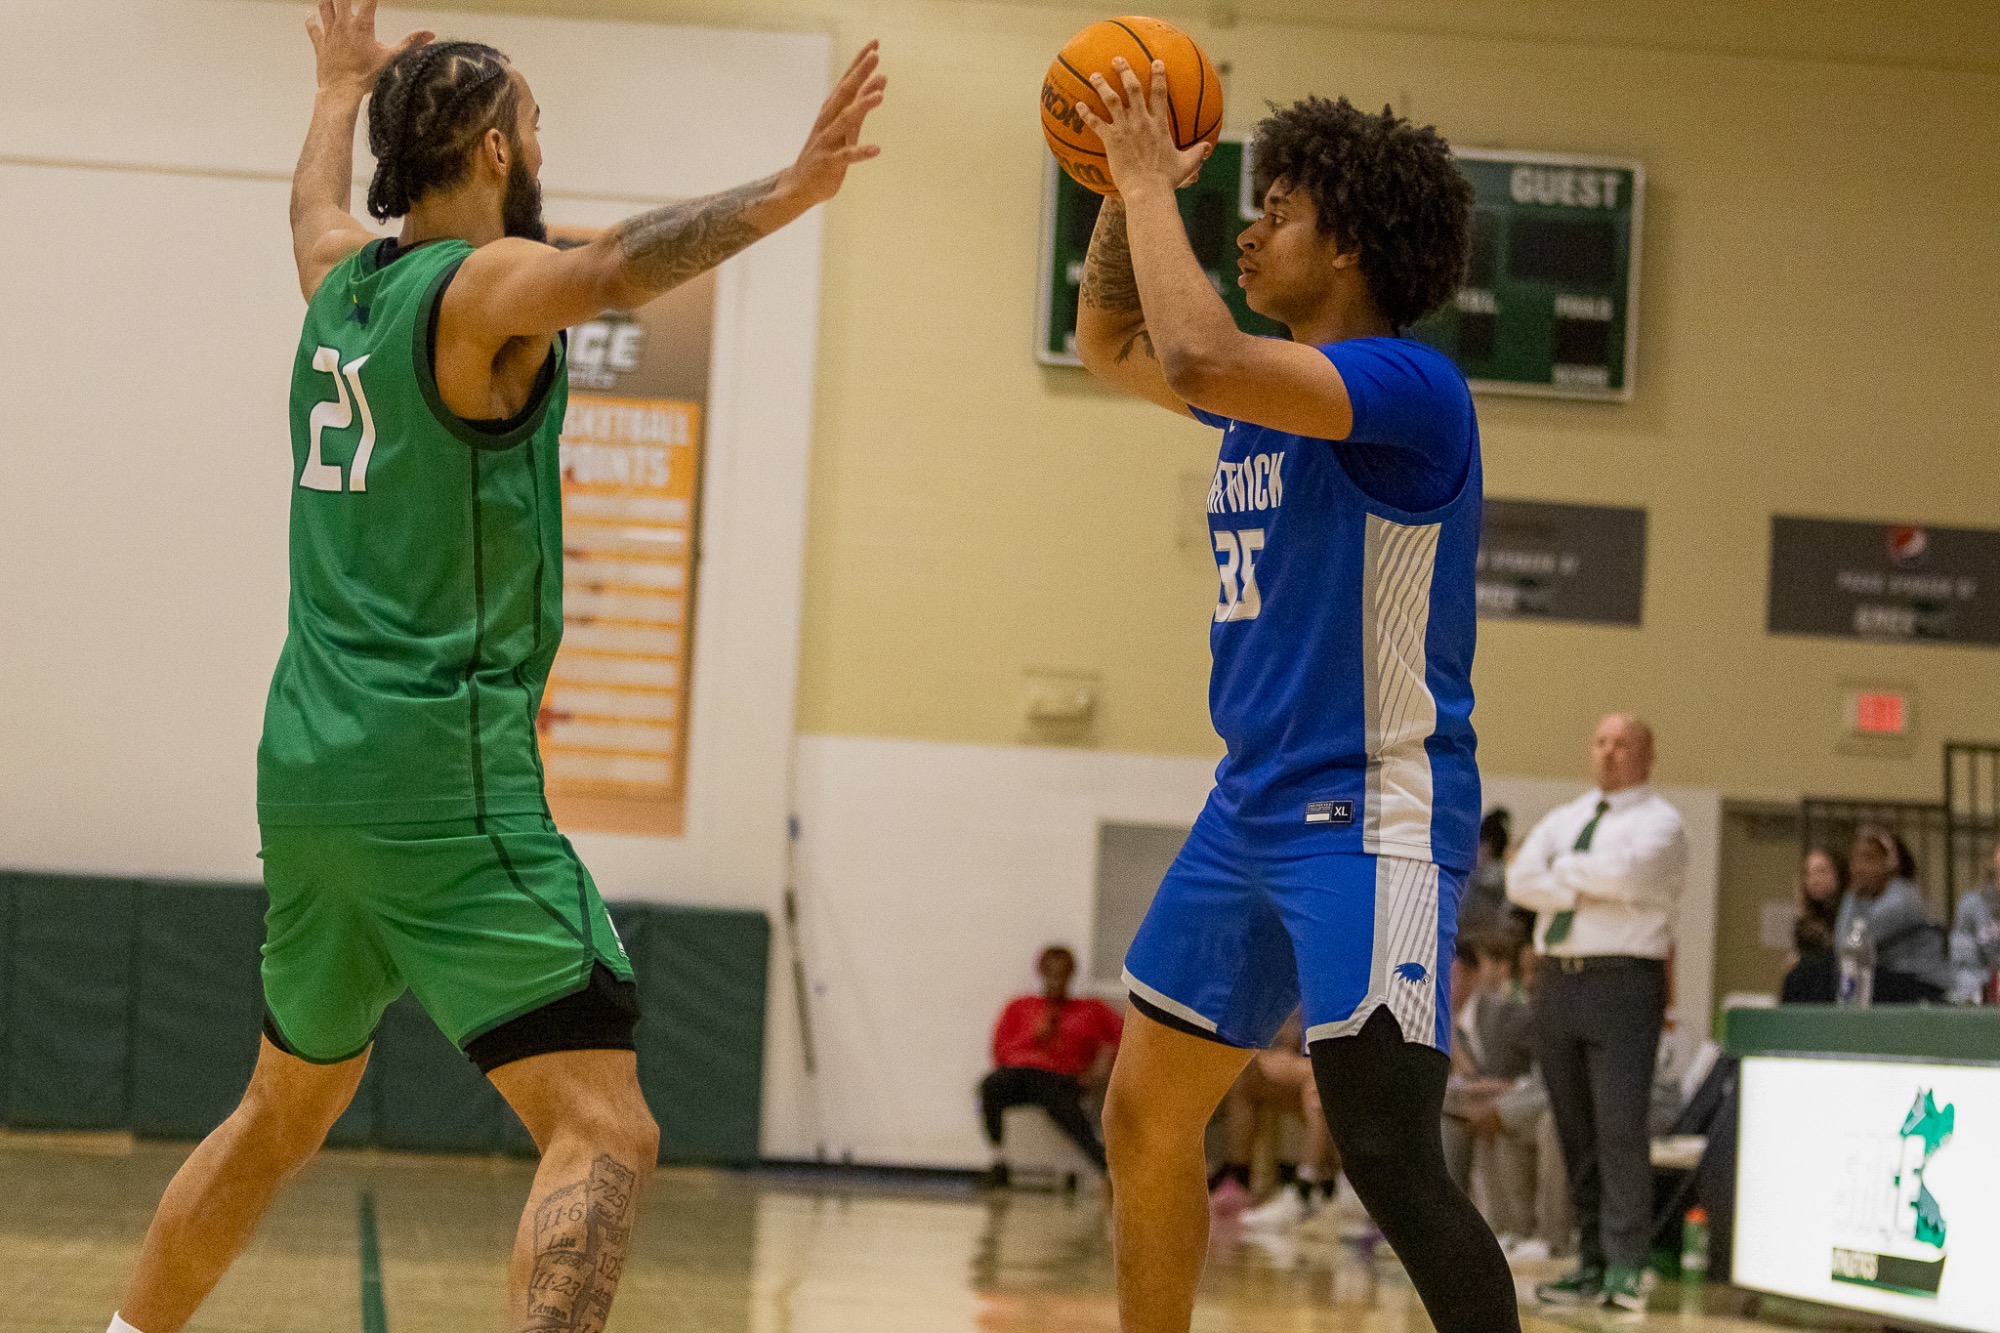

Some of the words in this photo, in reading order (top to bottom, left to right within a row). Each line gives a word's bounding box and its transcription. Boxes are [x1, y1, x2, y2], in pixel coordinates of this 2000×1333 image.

[1509, 166, 1623, 210] GUEST
[567, 320, 642, 371] GE
[299, 345, 377, 492] 21
[1214, 529, 1265, 623] 35
[1334, 806, 1349, 817] XL
